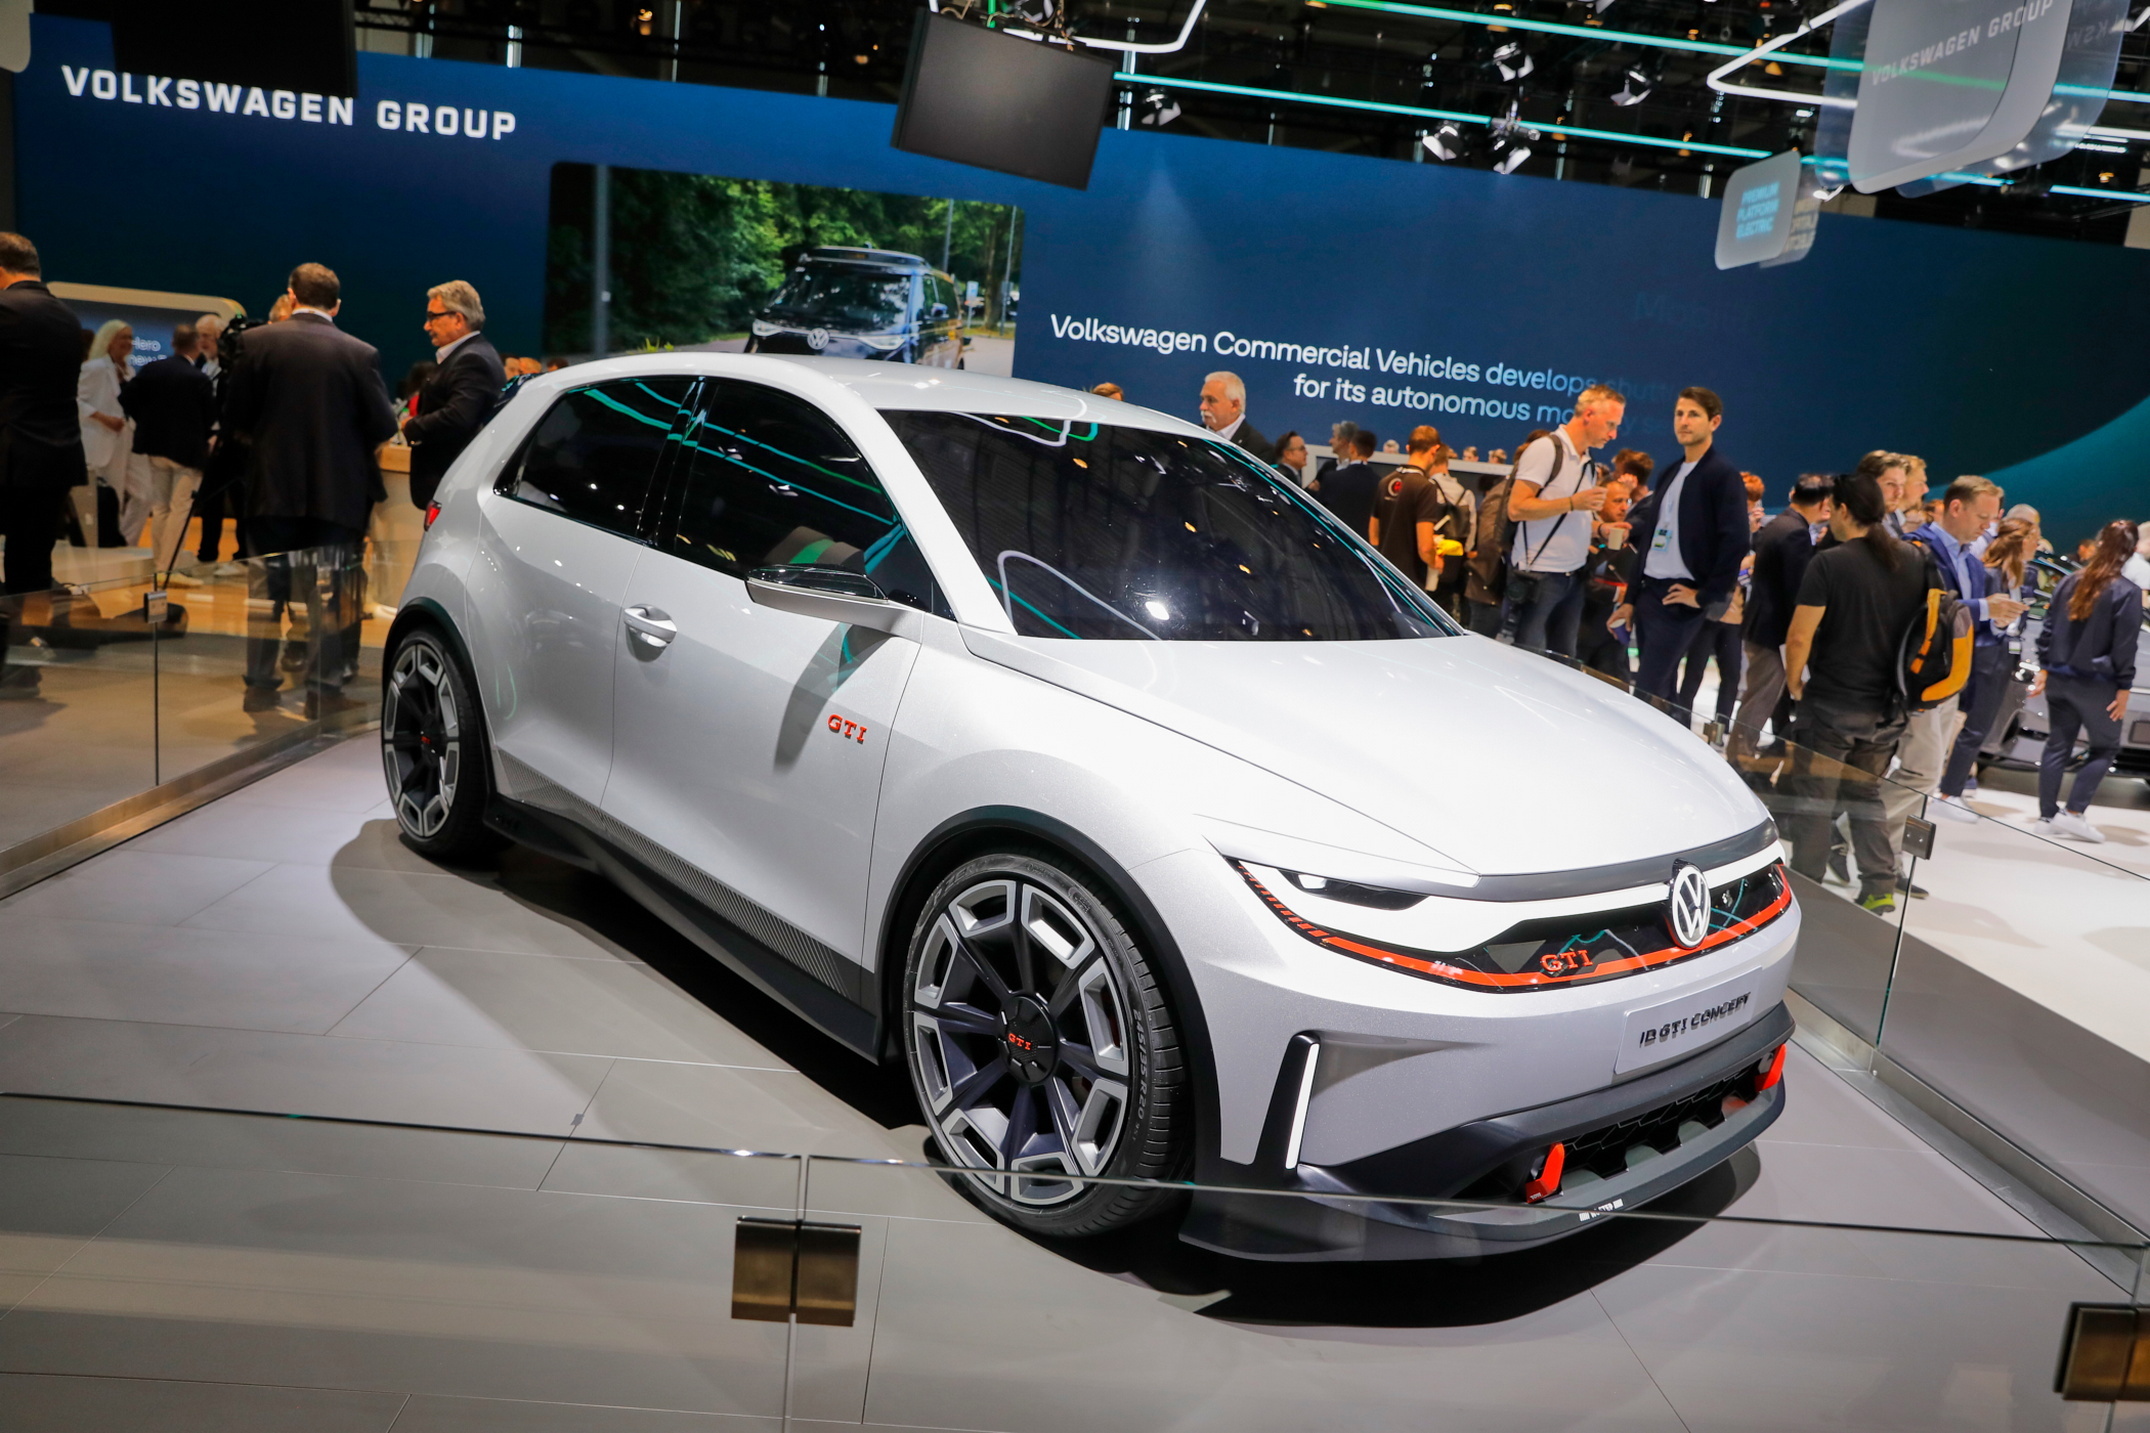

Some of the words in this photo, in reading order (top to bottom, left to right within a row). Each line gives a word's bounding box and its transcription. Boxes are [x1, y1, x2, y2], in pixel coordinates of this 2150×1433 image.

[1872, 26, 1981, 86] VOLKSWAGEN
[1987, 0, 2053, 39] GROUP
[61, 64, 354, 126] VOLKSWAGEN
[376, 100, 516, 140] GROUP
[1050, 314, 1207, 354] Volkswagen
[1213, 331, 1371, 370] Commercial
[1375, 348, 1480, 382] Vehicles
[1294, 373, 1331, 399] for
[1335, 376, 1366, 403] its
[1371, 386, 1531, 422] autonomous
[827, 713, 868, 743] GTI
[1540, 949, 1594, 973] GTI
[1658, 1017, 1689, 1038] GTI
[1690, 991, 1752, 1028] CONCEPT
[1008, 1032, 1033, 1051] GTI
[1132, 1008, 1148, 1078] 245/35
[1137, 1079, 1148, 1120] R20
